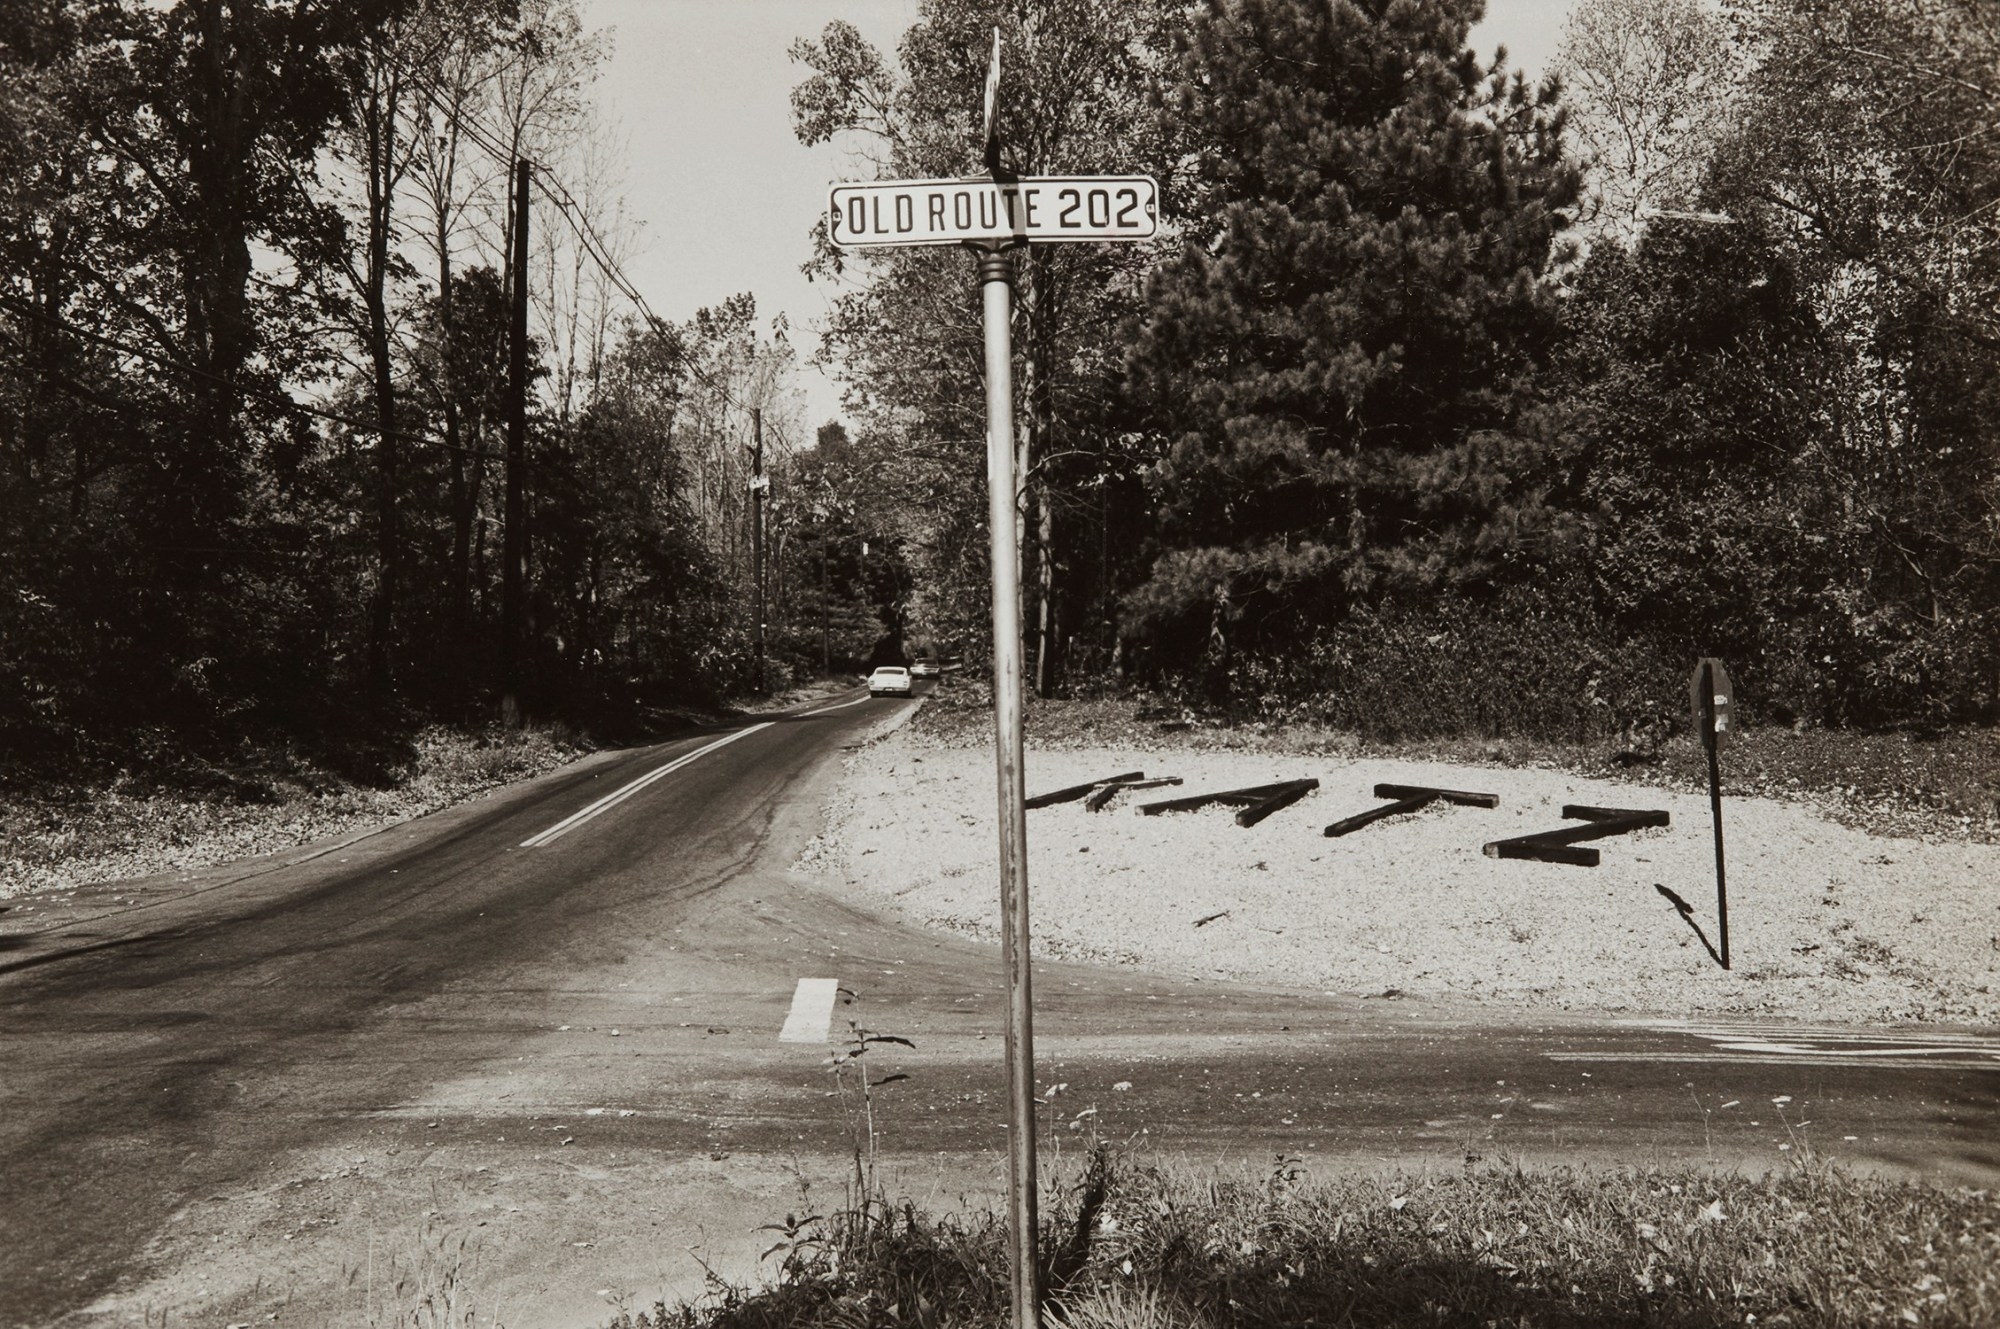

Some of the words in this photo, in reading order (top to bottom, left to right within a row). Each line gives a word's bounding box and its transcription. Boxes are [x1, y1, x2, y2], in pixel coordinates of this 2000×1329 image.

[849, 195, 913, 235] OLD
[928, 189, 1042, 232] ROUTE
[1058, 189, 1139, 228] 202
